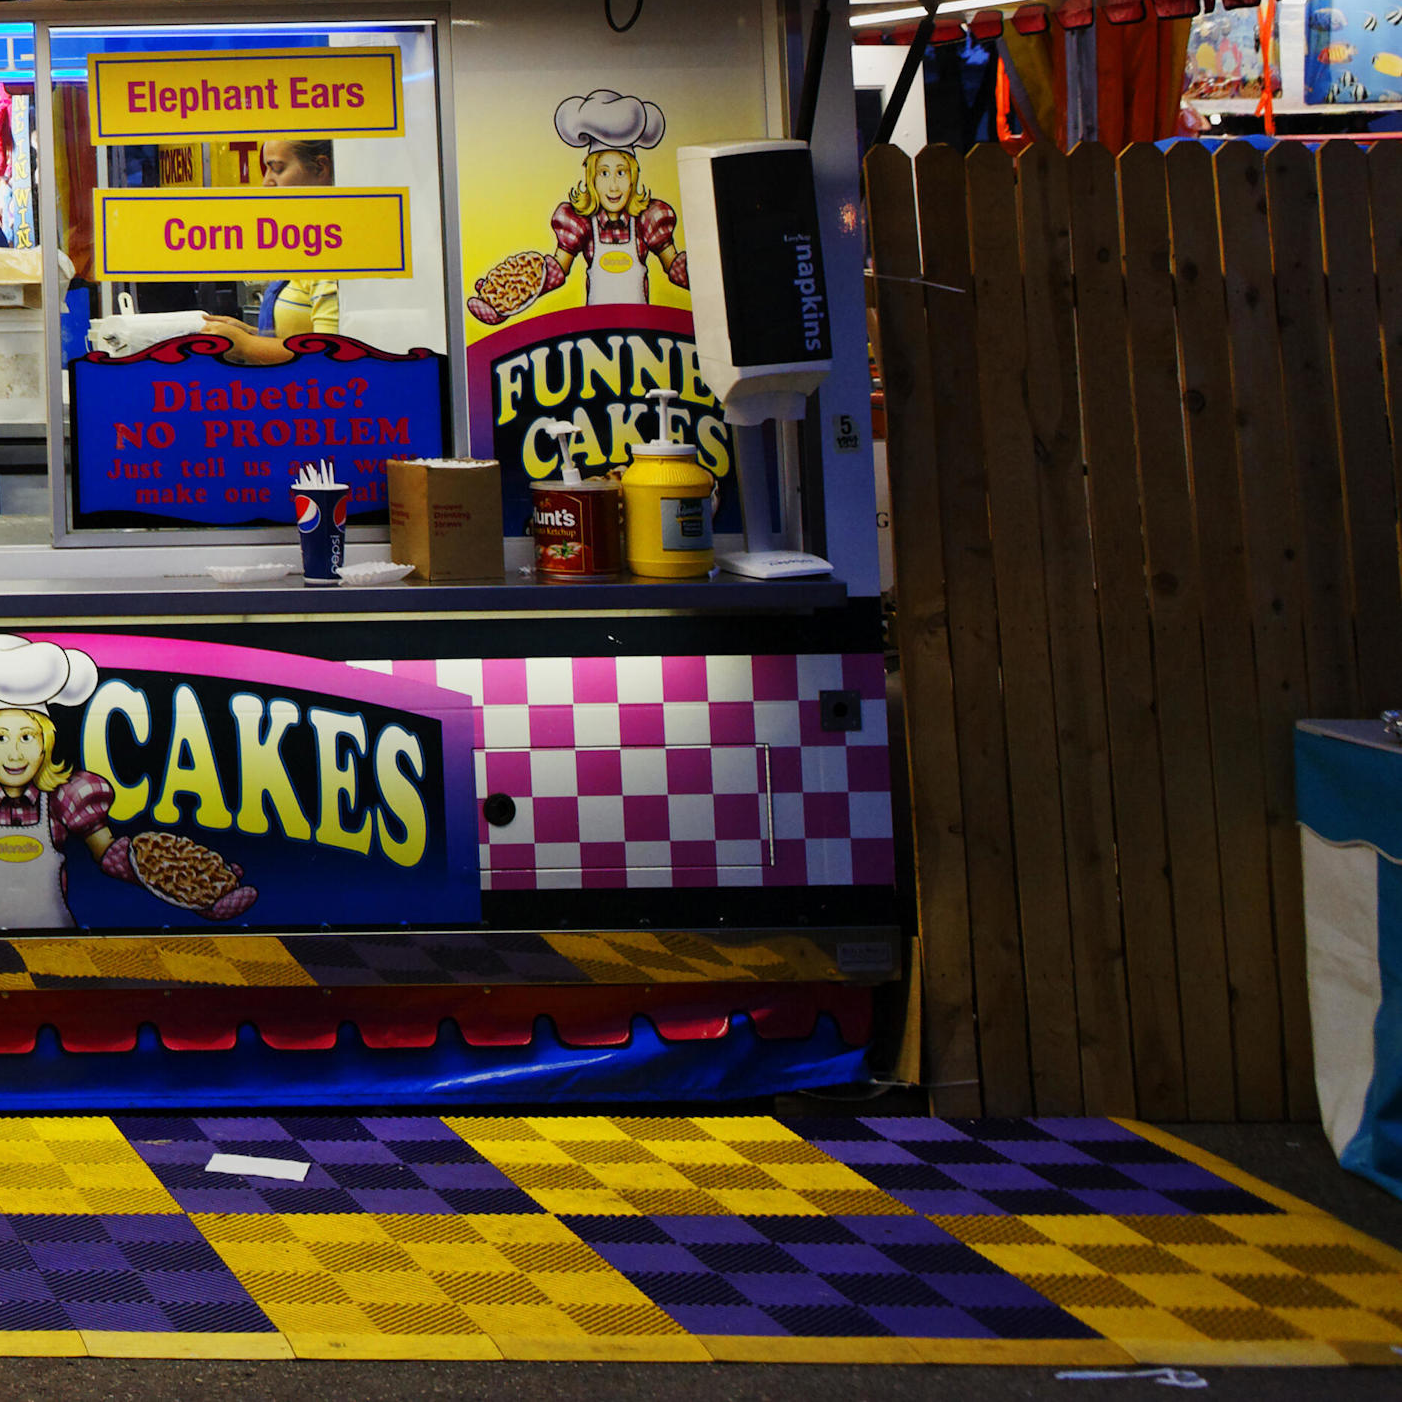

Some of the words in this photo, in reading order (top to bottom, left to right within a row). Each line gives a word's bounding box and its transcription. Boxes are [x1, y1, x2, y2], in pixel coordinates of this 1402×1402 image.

[127, 78, 279, 119] Elephant
[290, 76, 365, 109] Ears
[159, 146, 194, 185] TOKENS
[164, 218, 244, 251] Corn
[257, 217, 343, 256] Dogs
[794, 244, 824, 351] napkins
[152, 377, 369, 413] Diabetic?
[496, 334, 725, 427] FUNNE
[114, 421, 176, 450] NO
[203, 418, 411, 448] PROBLEM
[840, 415, 853, 435] 5
[107, 458, 162, 480] Just
[181, 457, 226, 478] tell
[244, 460, 271, 477] us
[135, 484, 208, 504] make
[224, 487, 271, 504] one
[434, 511, 471, 521] Drinking
[80, 678, 429, 869] CAKES
